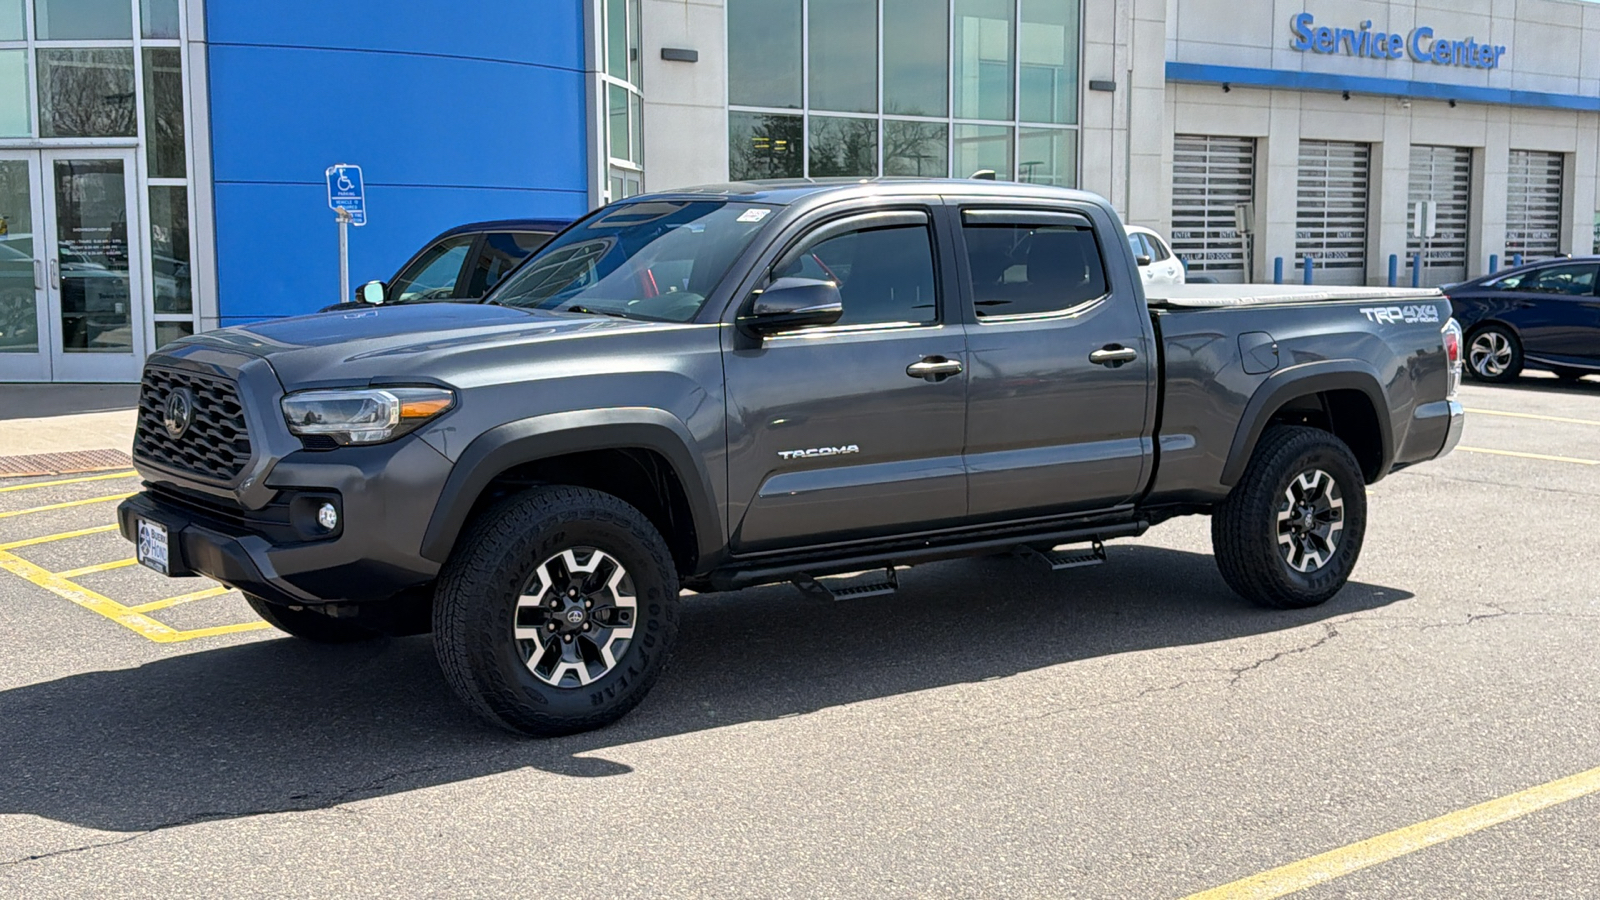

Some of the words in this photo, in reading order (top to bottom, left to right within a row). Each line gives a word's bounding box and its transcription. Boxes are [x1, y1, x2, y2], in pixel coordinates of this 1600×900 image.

[1291, 12, 1403, 59] Service
[1407, 26, 1506, 69] Center
[1360, 306, 1404, 325] TRD
[1403, 305, 1438, 318] 4X4
[778, 444, 860, 460] TACOMA
[590, 586, 661, 706] GOODYEAR
